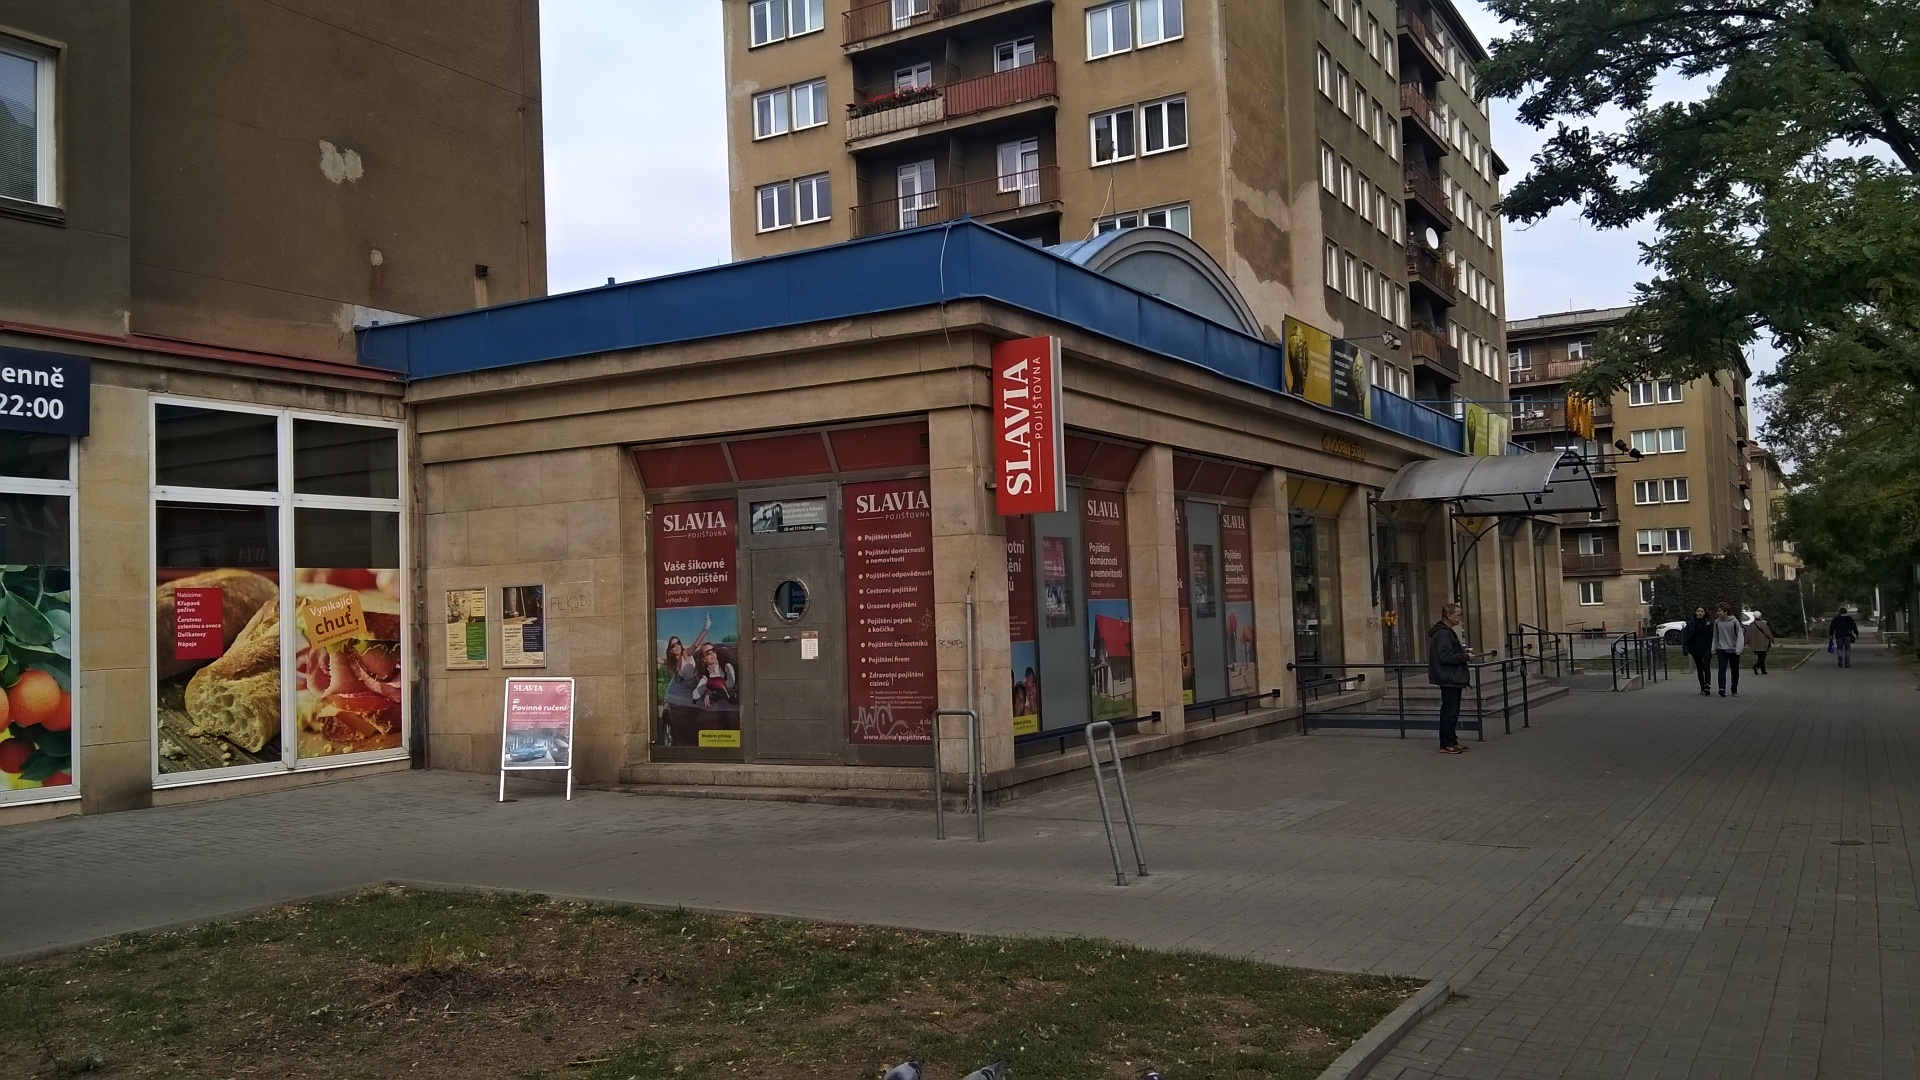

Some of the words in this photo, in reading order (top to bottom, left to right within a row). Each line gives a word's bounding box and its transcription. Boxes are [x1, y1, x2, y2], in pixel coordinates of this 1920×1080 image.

[0, 392, 64, 420] 22:00
[1003, 358, 1032, 496] SLAVIA
[856, 490, 930, 513] SLAVIA
[1087, 500, 1120, 518] SLAVIA
[663, 510, 727, 532] SLAVIA
[1223, 514, 1246, 530] SLAVIA
[864, 533, 890, 542] Pojištění
[890, 531, 912, 540] vozidel
[865, 548, 891, 557] Pojištění
[890, 546, 926, 555] domácnosti
[664, 560, 687, 572] Vaše
[687, 557, 725, 571] šikovné
[870, 556, 905, 564] nemovitosti
[1089, 556, 1118, 566] domácnosti
[664, 571, 729, 587] autopojištění
[865, 572, 891, 581] Pojištění
[891, 569, 933, 579] odpovědnosti
[1094, 568, 1123, 579] nemovitosti
[668, 588, 694, 597] povinnost
[866, 587, 891, 595] Cestovní
[891, 586, 918, 594] pojištění
[309, 594, 354, 617] Vynikající
[866, 602, 890, 610] Úrazové
[891, 601, 917, 610] pojištění
[177, 615, 202, 623] Čerstvou
[867, 618, 893, 626] Pojištění
[867, 641, 893, 650] Pojištění
[868, 656, 894, 665] Pojištění
[894, 655, 910, 663] firem
[897, 671, 924, 679] pojištění
[513, 684, 544, 692] SLAVIA
